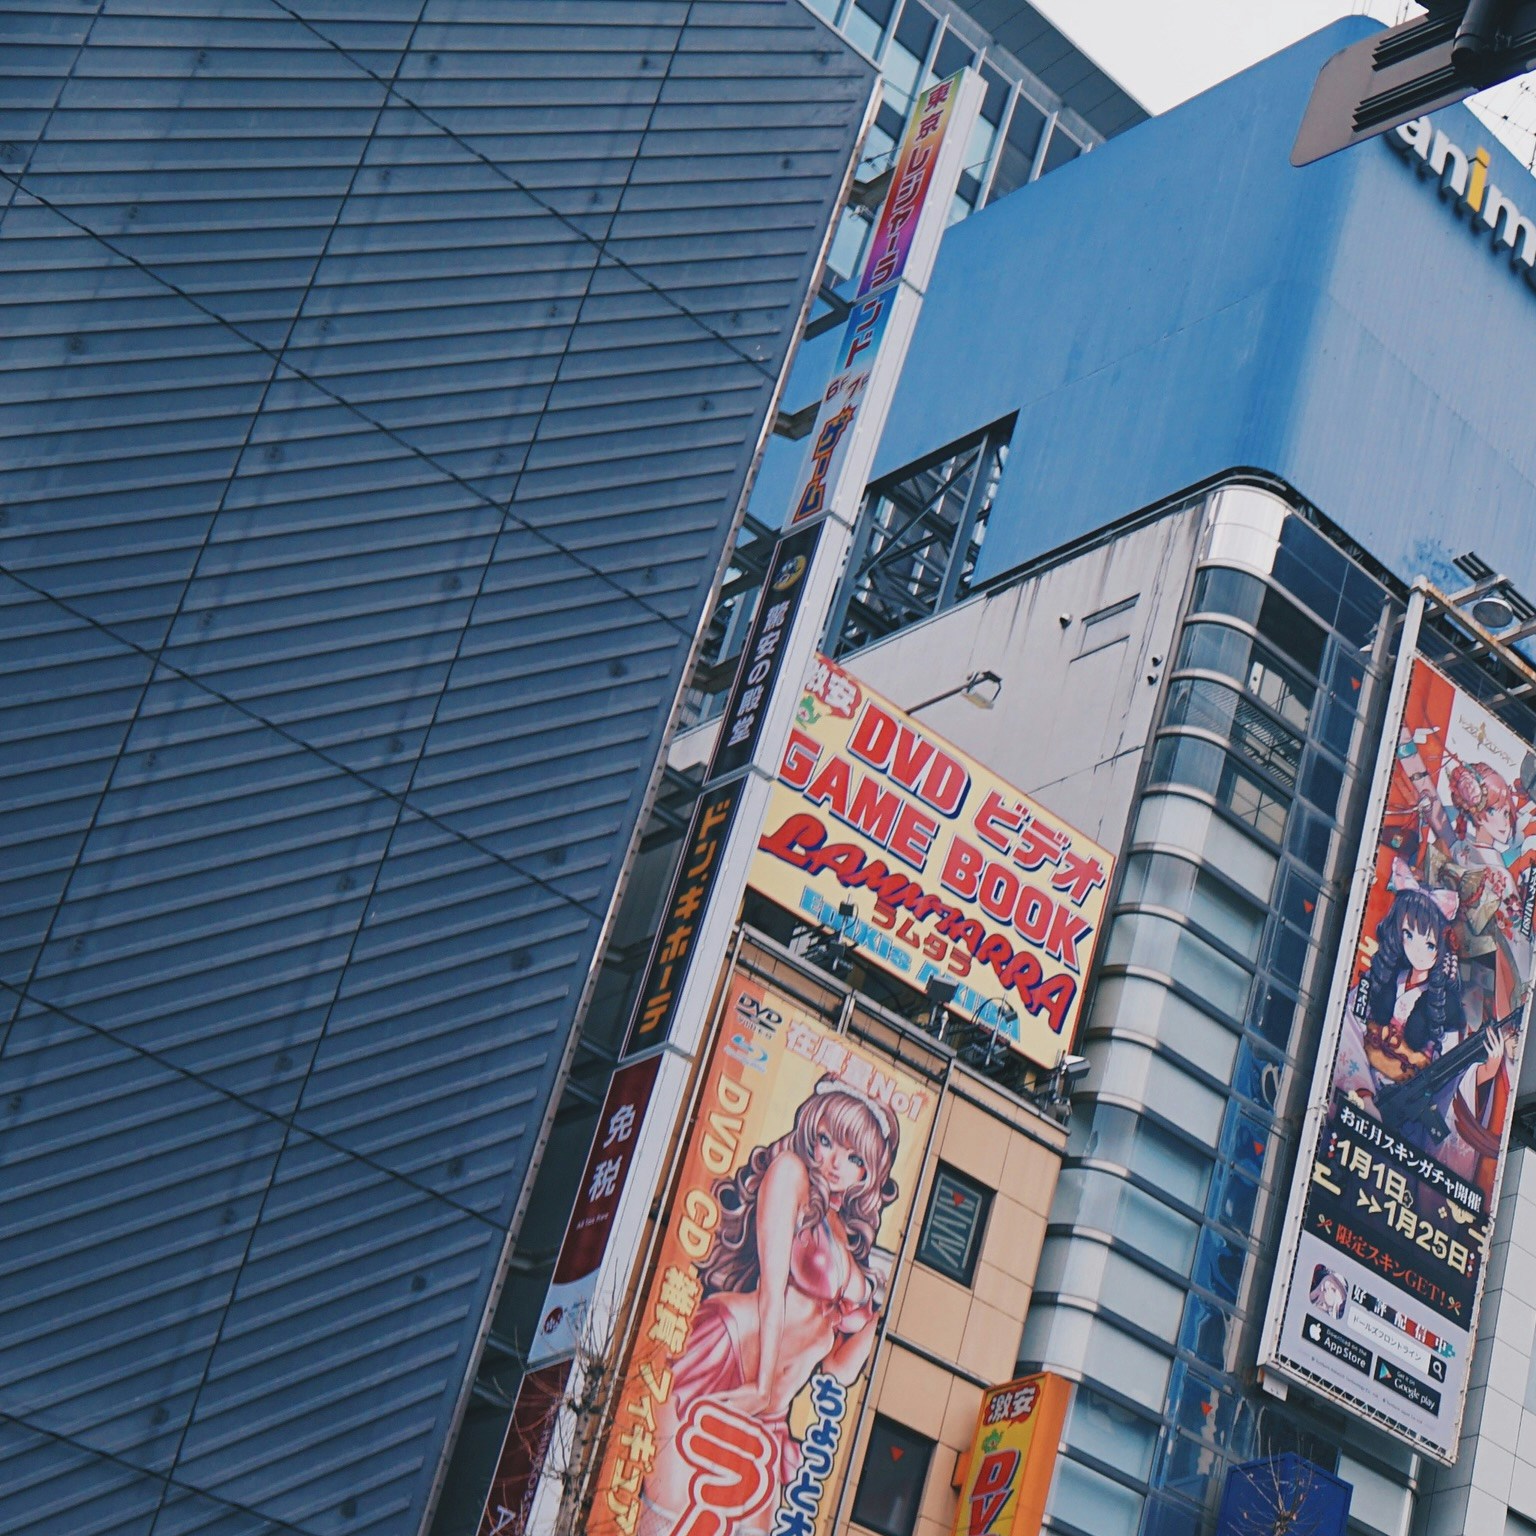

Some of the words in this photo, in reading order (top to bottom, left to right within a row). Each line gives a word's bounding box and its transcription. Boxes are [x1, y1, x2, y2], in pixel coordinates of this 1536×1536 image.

[848, 701, 971, 816] DVD
[973, 788, 1106, 905] ビデオ
[779, 729, 938, 871] GAME
[940, 833, 1092, 974] BOOK
[870, 899, 973, 979] ラムタラ
[587, 1104, 640, 1201] 免税
[712, 1078, 755, 1176] DVD
[1340, 1105, 1483, 1214] お正月スキンガチャ開催
[1335, 1137, 1408, 1206] 1月1日
[677, 1190, 721, 1261] CD
[1335, 1223, 1448, 1308] 限定スキンGET!
[1383, 1204, 1471, 1276] 1月25日
[651, 1265, 704, 1357] 雑貨
[1323, 1336, 1343, 1357] App
[1342, 1346, 1367, 1369] Store
[987, 1383, 1038, 1421] 激安
[1394, 1378, 1420, 1400] Google
[1420, 1393, 1436, 1411] play
